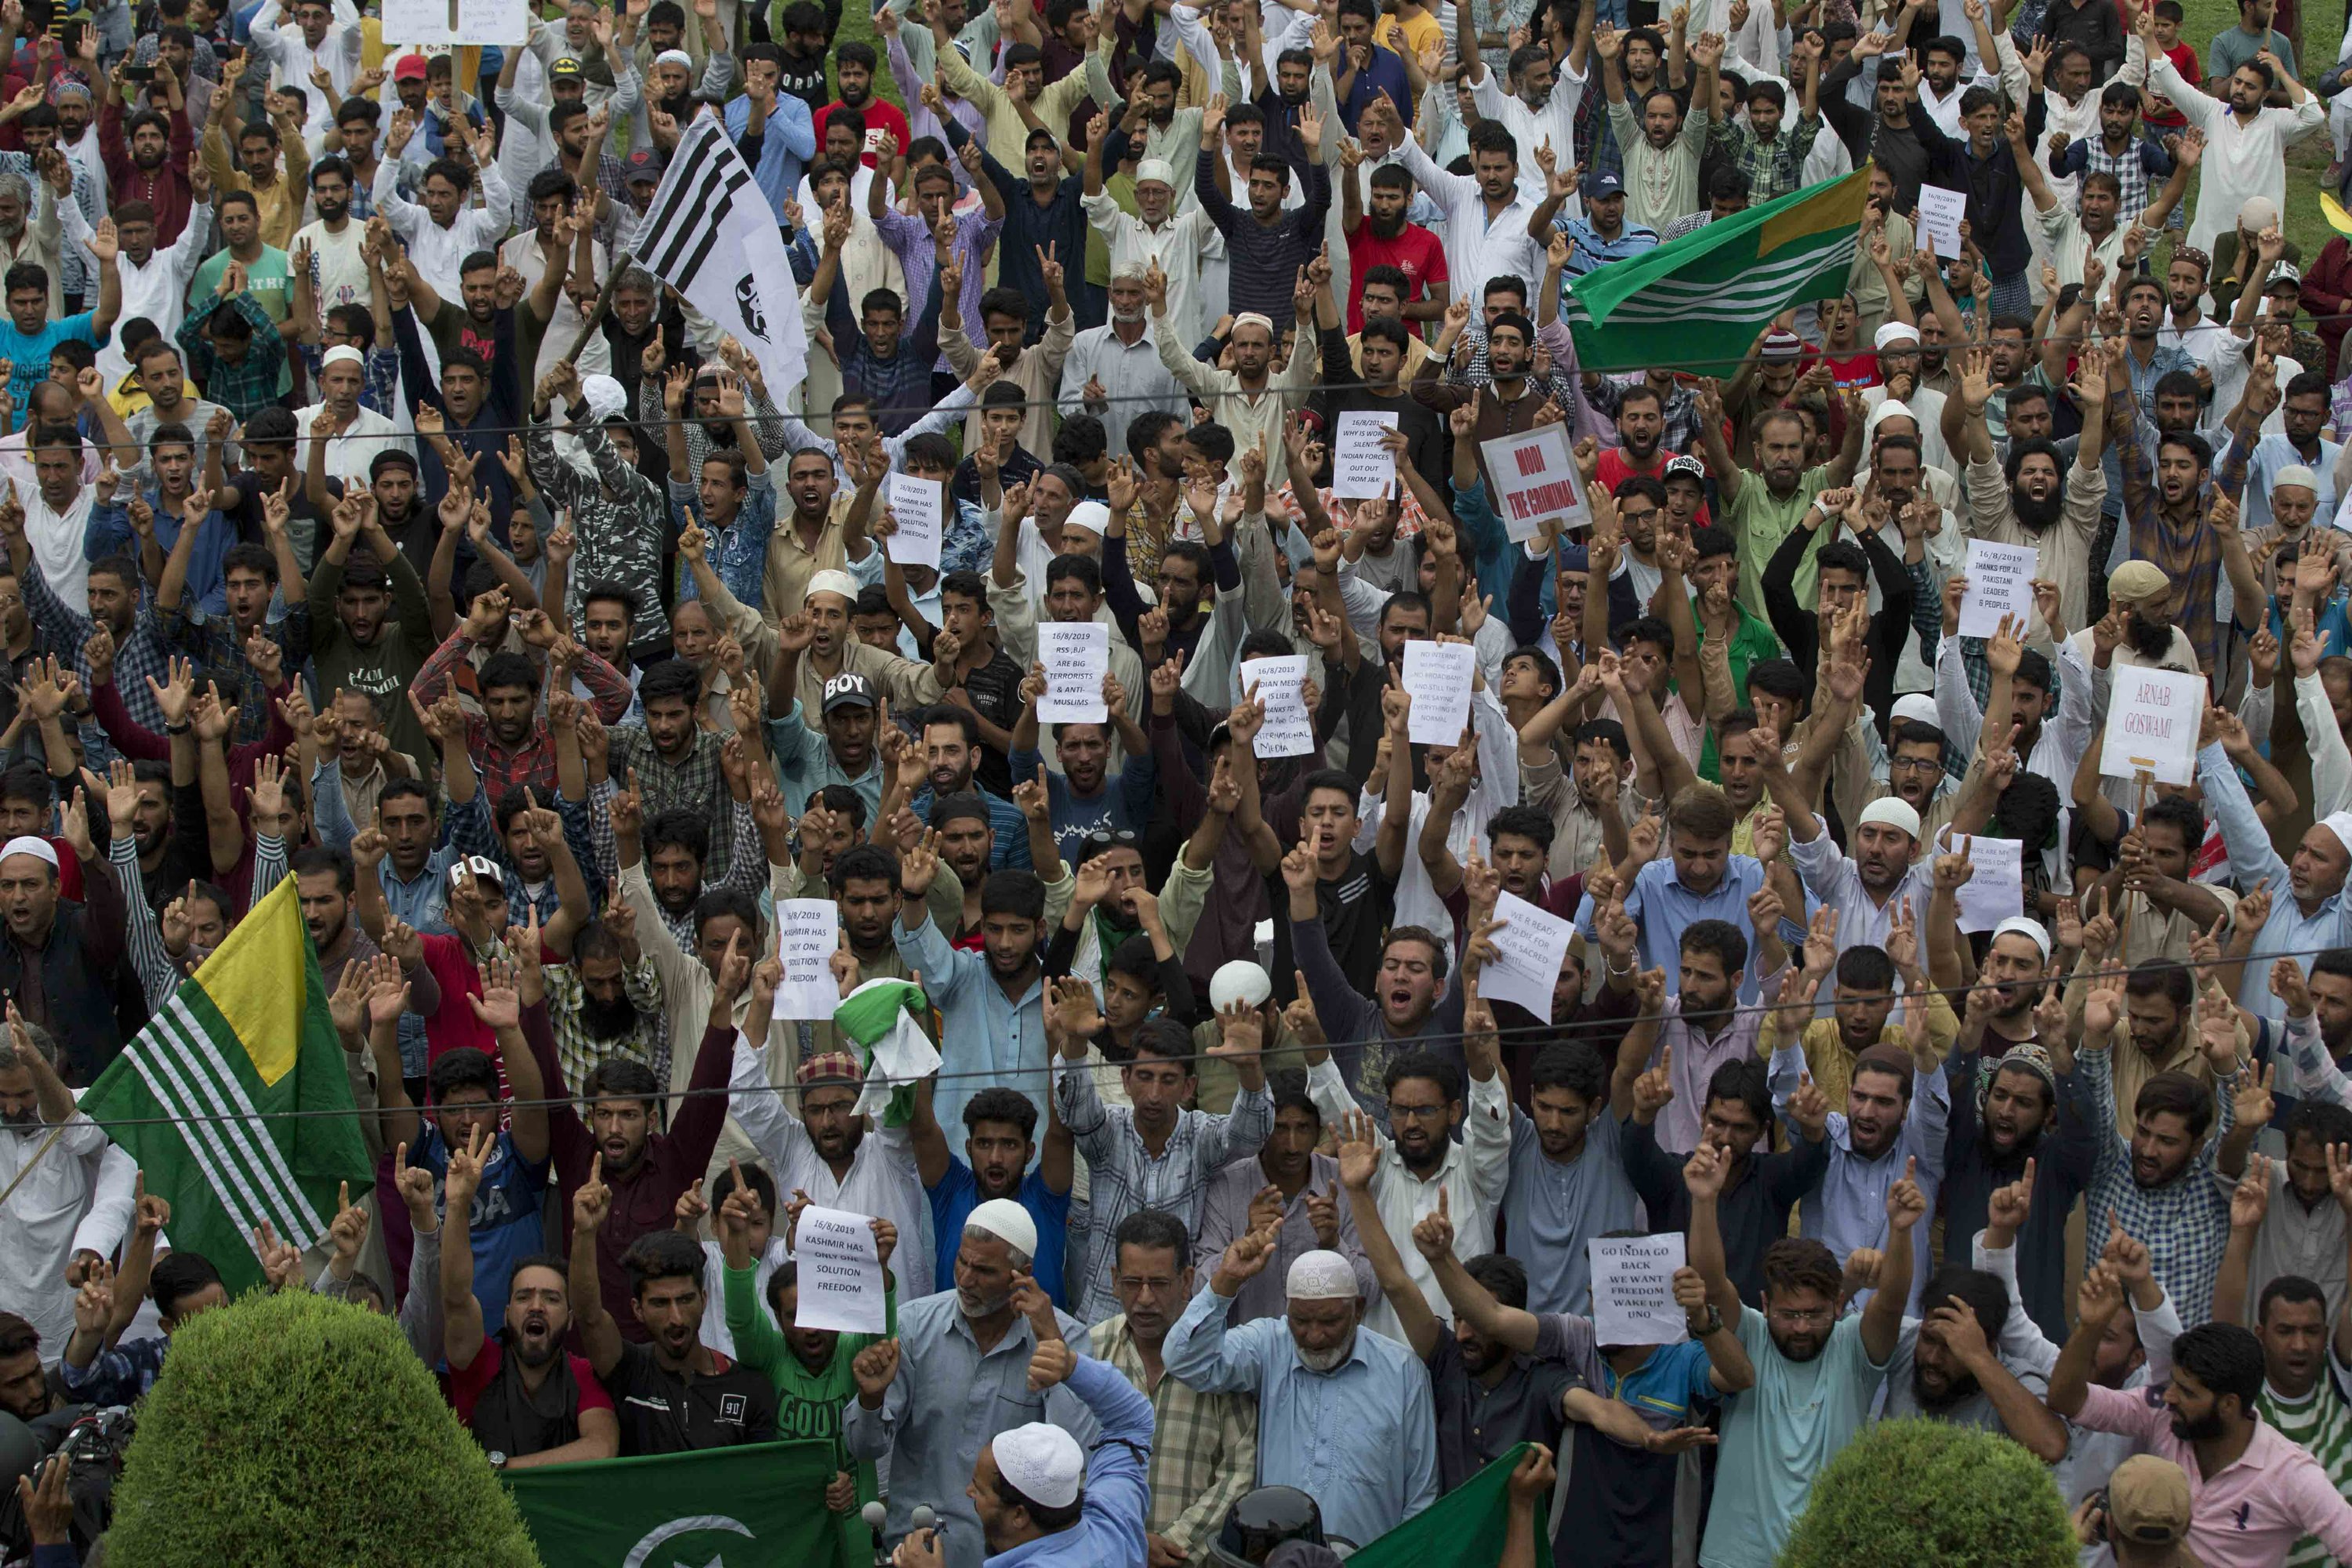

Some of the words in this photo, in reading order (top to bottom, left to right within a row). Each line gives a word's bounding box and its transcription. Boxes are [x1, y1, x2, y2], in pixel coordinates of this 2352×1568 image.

[1928, 193, 1957, 203] 16/8/2019
[1514, 444, 1546, 477] MODI
[899, 484, 927, 495] 16/8/2019
[895, 495, 919, 506] KASHMIR
[1506, 491, 1531, 521] THE
[1526, 479, 1578, 516] CRIMINAL
[899, 518, 928, 528] SOLUTION
[901, 529, 929, 539] FREEDOM
[1980, 550, 2022, 562] 16/8/2019
[1975, 562, 1998, 572] THANKS
[1982, 575, 2013, 585] PAKISTANI
[1983, 587, 2009, 597] LEADERS
[1984, 600, 2011, 610] PEOPLES
[363, 668, 383, 682] AM
[1258, 666, 1295, 675] 16/8/2019
[826, 674, 864, 701] BOY
[2135, 683, 2171, 706] ARNAB
[1413, 704, 1450, 713] EVERYTHING
[2125, 713, 2172, 739] GOSWAMI
[1510, 911, 1524, 922] WE
[1525, 917, 1530, 926] R
[1531, 921, 1558, 937] READY
[784, 927, 810, 937] KASHMIR
[1508, 924, 1519, 935] TO
[1519, 930, 1534, 942] DIE
[1534, 937, 1550, 950] FOR
[789, 942, 801, 952] ONLY
[803, 942, 821, 951] ONE
[1501, 936, 1517, 949] OUR
[1519, 946, 1548, 964] SACRED
[789, 957, 819, 966] SOLUTION
[789, 974, 817, 982] FREEDOM
[814, 1219, 855, 1235] 16/8/2019
[805, 1235, 844, 1249] KASHMIR
[846, 1243, 864, 1252] HAS
[1620, 1247, 1650, 1256] INDIA
[1653, 1247, 1668, 1256] GO
[816, 1265, 861, 1276] SOLUTION
[1621, 1261, 1651, 1270] BACK
[818, 1282, 862, 1293] FREEDOM
